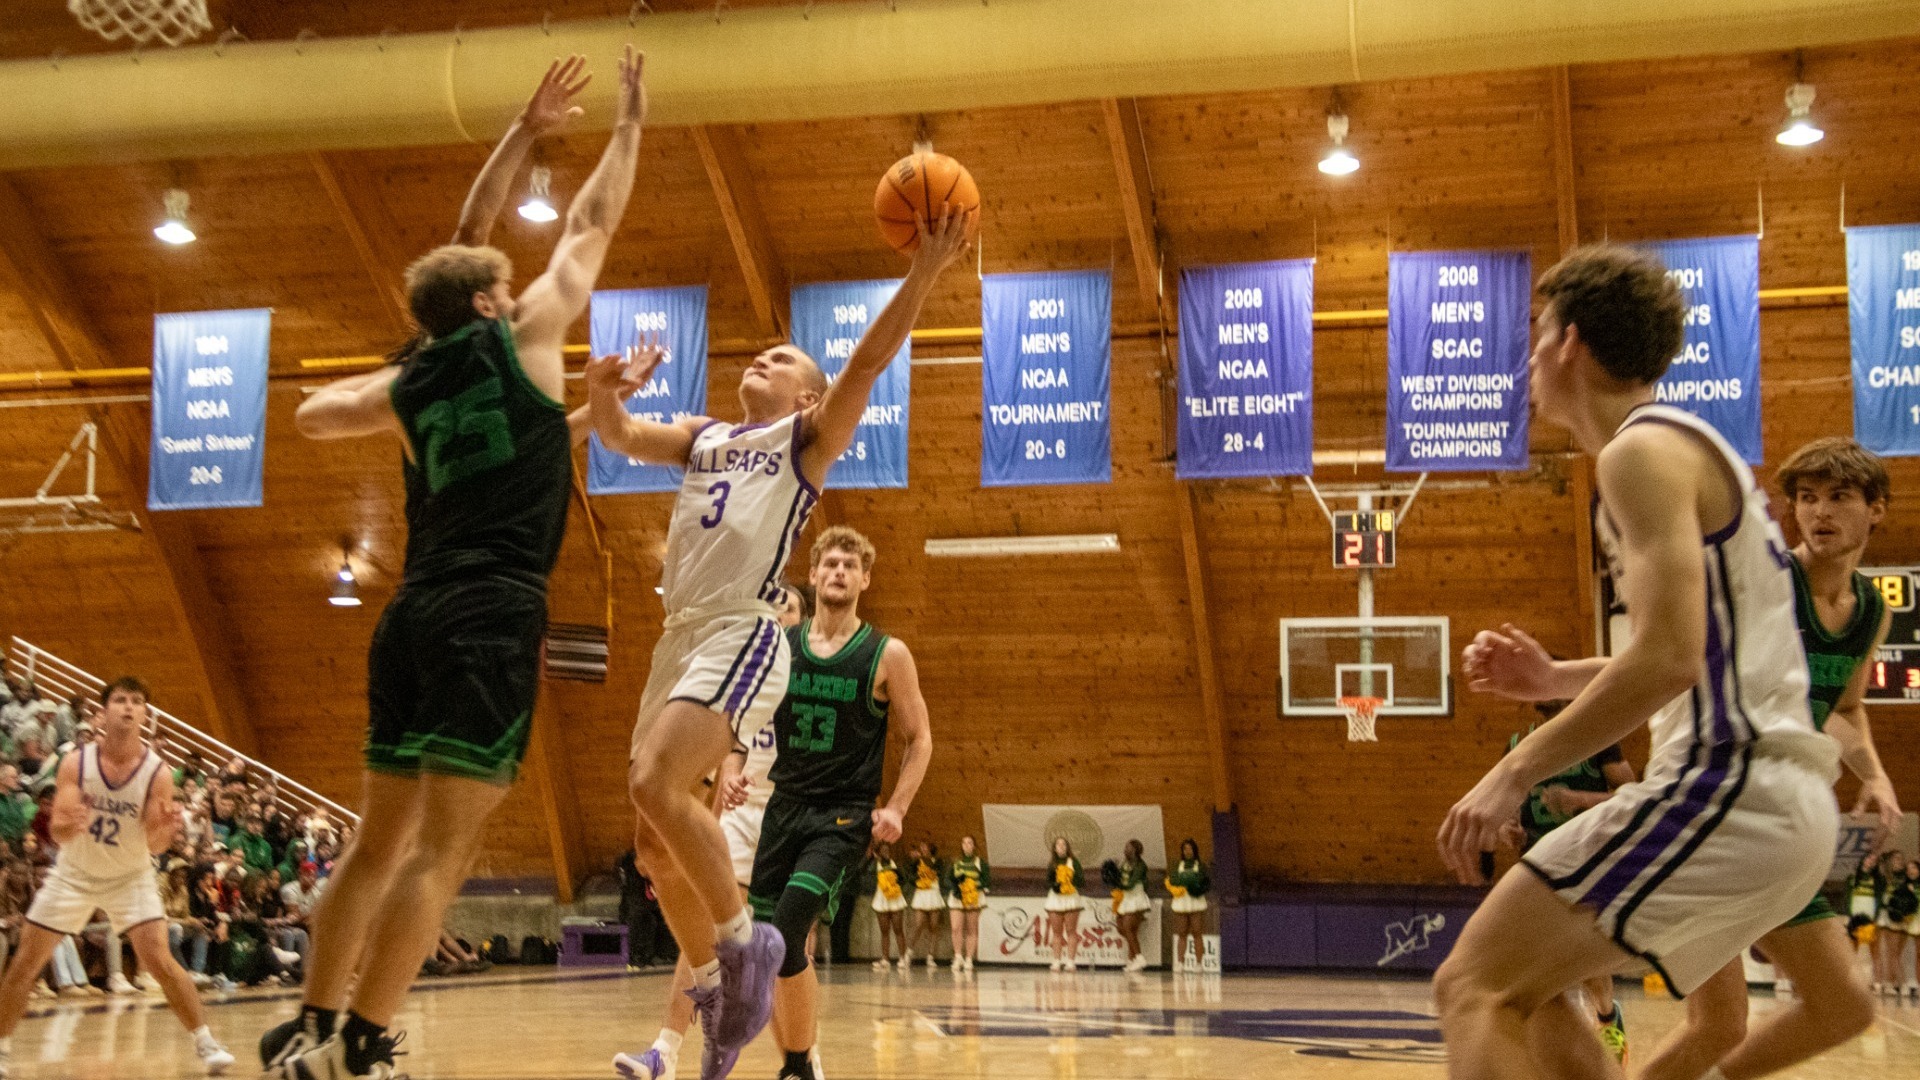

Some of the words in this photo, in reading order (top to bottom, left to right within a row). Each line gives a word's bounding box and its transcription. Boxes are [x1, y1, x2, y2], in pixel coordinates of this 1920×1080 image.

[1438, 266, 1478, 286] 2008
[1029, 299, 1064, 320] 2001
[1225, 288, 1262, 310] 2008
[833, 304, 867, 324] 1996
[1432, 301, 1484, 323] MEN'S
[1022, 332, 1070, 354] MEN'S
[1218, 323, 1269, 344] MEN'S
[1432, 338, 1482, 359] SCAC
[1022, 368, 1068, 390] NCAA
[1219, 359, 1268, 380] NCAA
[1401, 376, 1444, 393] WEST
[1448, 374, 1514, 392] DIVISION
[187, 399, 230, 420] NCAA
[1186, 396, 1240, 417] "ELITE
[1244, 392, 1303, 414] EIGHT"
[1411, 393, 1502, 411] CHAMPIONS
[989, 401, 1102, 425] TOURNAMENT
[415, 377, 516, 494] 25
[1404, 422, 1510, 440] TOURNAMENT
[1410, 440, 1502, 458] CHAMPIONS
[700, 481, 731, 529] 3
[1344, 534, 1383, 566] 21
[789, 702, 837, 752] 33
[89, 816, 120, 846] 42
